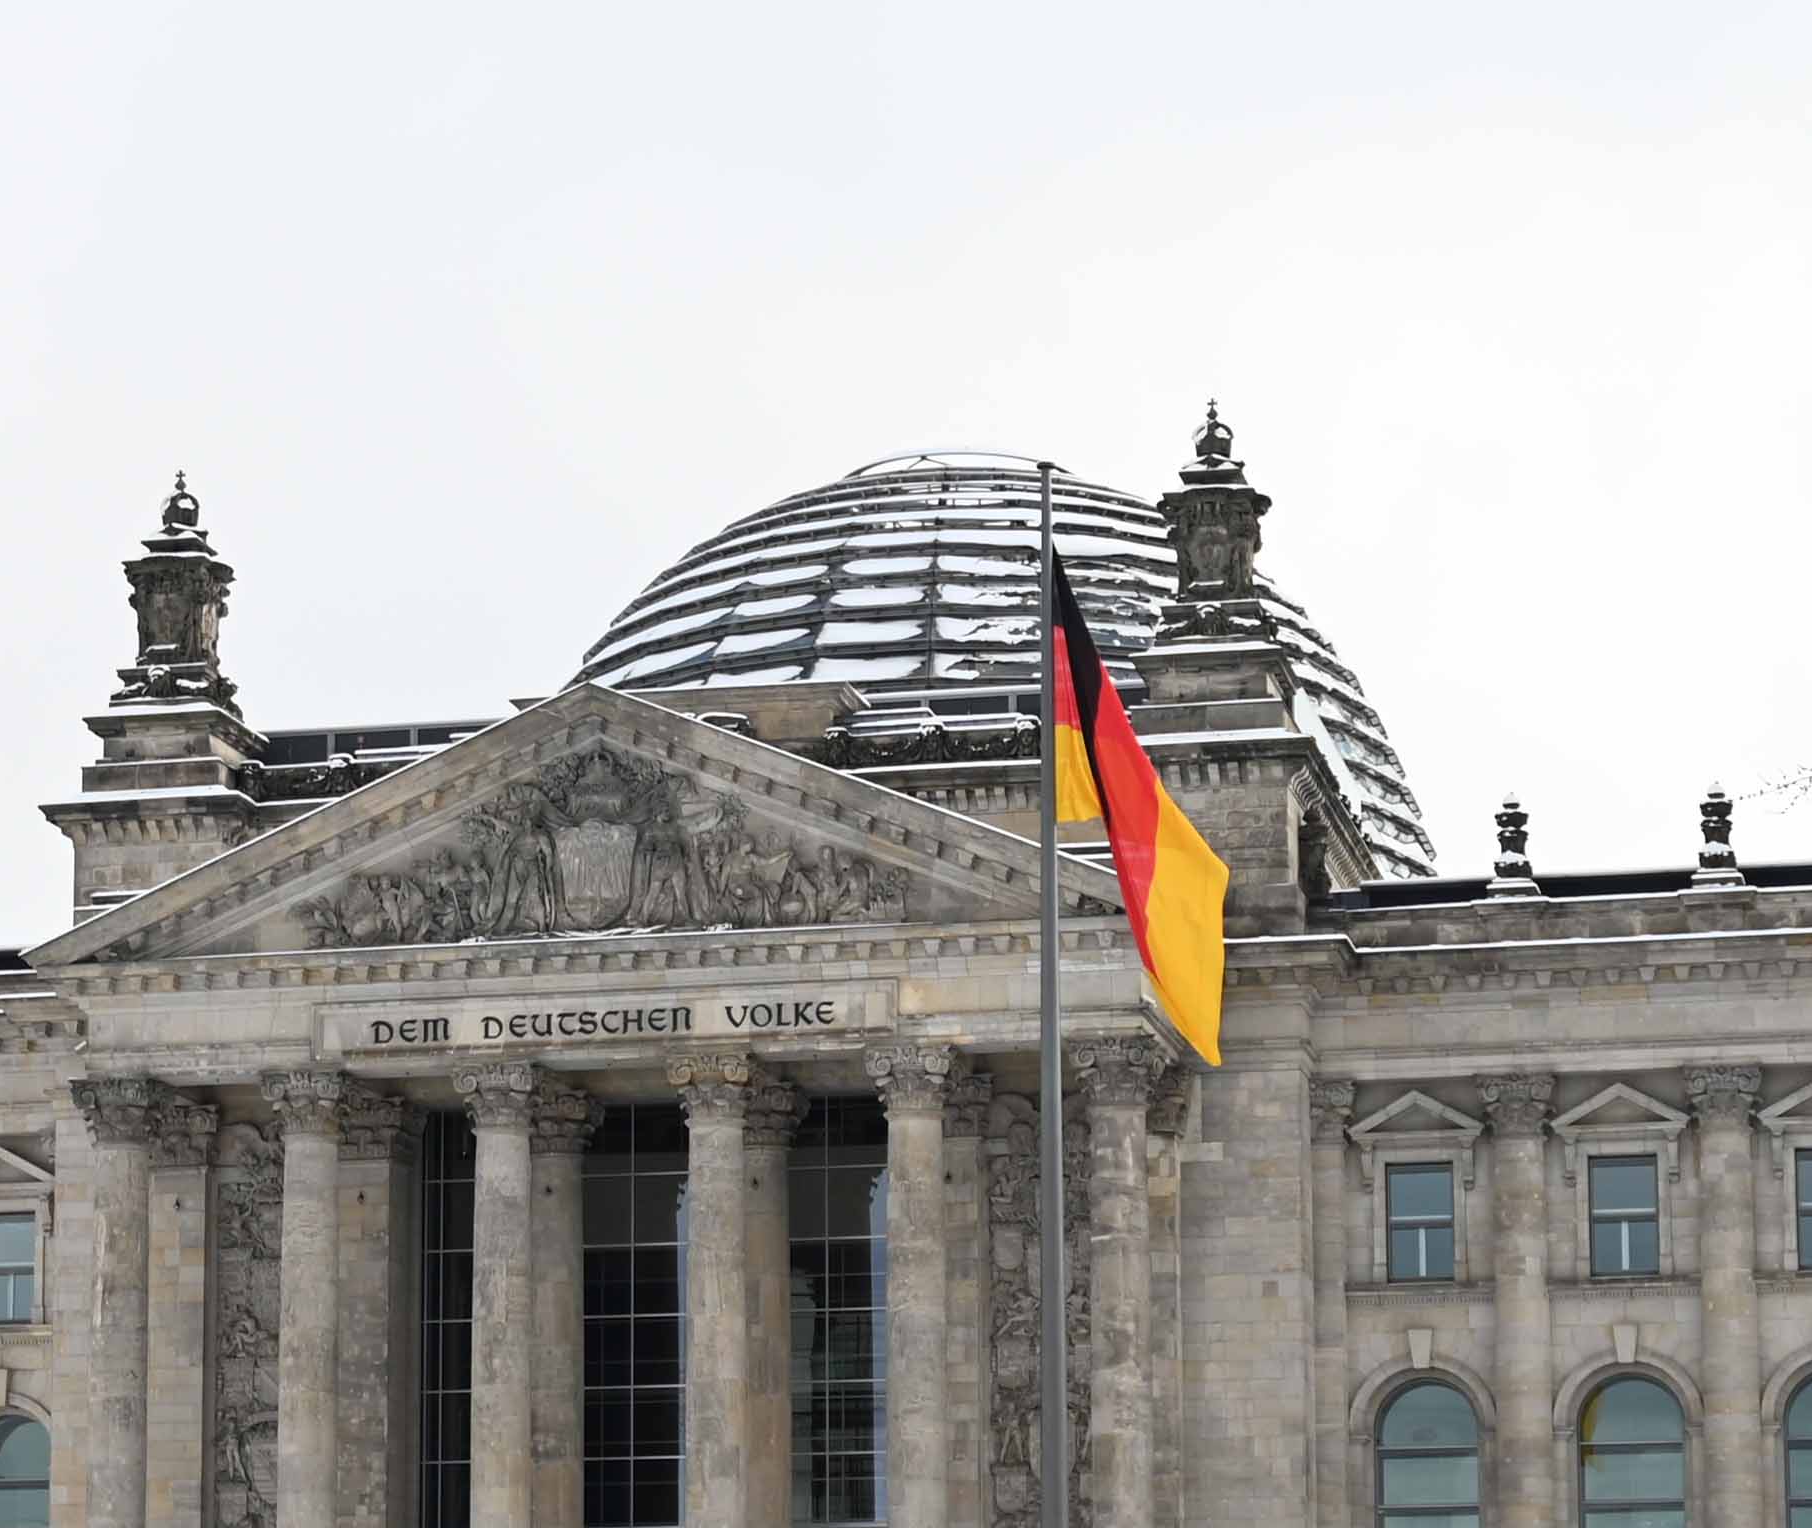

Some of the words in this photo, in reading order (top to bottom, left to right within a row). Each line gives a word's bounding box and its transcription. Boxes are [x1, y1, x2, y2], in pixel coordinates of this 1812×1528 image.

[370, 1017, 451, 1044] DEM
[480, 1006, 693, 1040] DEUTSCHEN
[724, 1001, 836, 1028] VOLKE
